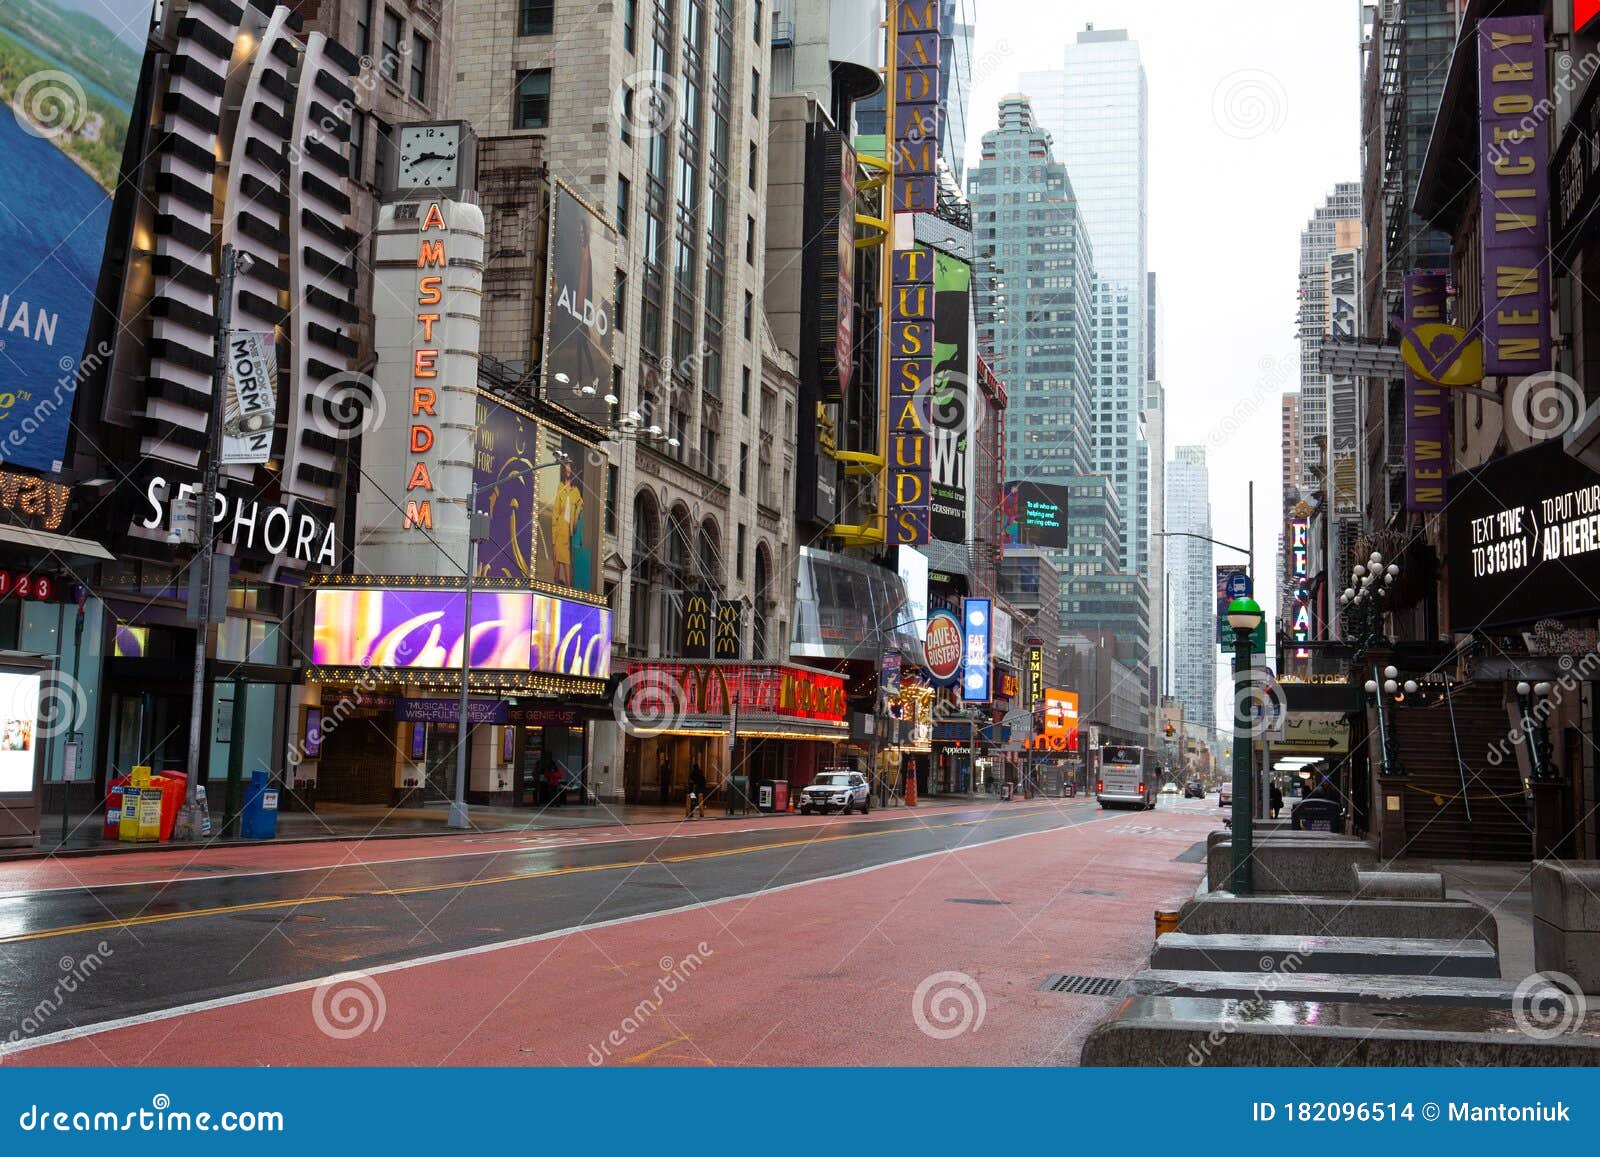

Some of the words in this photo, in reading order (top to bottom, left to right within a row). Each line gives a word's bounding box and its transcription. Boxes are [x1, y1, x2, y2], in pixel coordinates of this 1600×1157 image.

[900, 1, 936, 208] MADAME
[425, 129, 434, 138] 12
[1491, 32, 1537, 233] VICTORY
[1331, 253, 1355, 295] NEW
[557, 284, 609, 337] ALDO
[1496, 265, 1540, 361] NEW
[403, 203, 447, 529] AMSTERDAM
[1412, 285, 1442, 417] VIRY
[1414, 440, 1443, 503] NEW
[143, 476, 336, 567] SPHORA
[931, 503, 960, 517] GERSHWIN
[1027, 509, 1045, 518] helping
[1542, 499, 1554, 526] TO
[1555, 492, 1573, 520] PUT
[1574, 484, 1600, 514] YOUR
[1471, 514, 1495, 545] TEXT
[1543, 526, 1561, 562] AD
[1471, 547, 1486, 578] TO
[1486, 536, 1528, 575] 313131
[927, 627, 951, 650] DAVE
[951, 626, 959, 643] &
[1300, 674, 1349, 685] VICTORY
